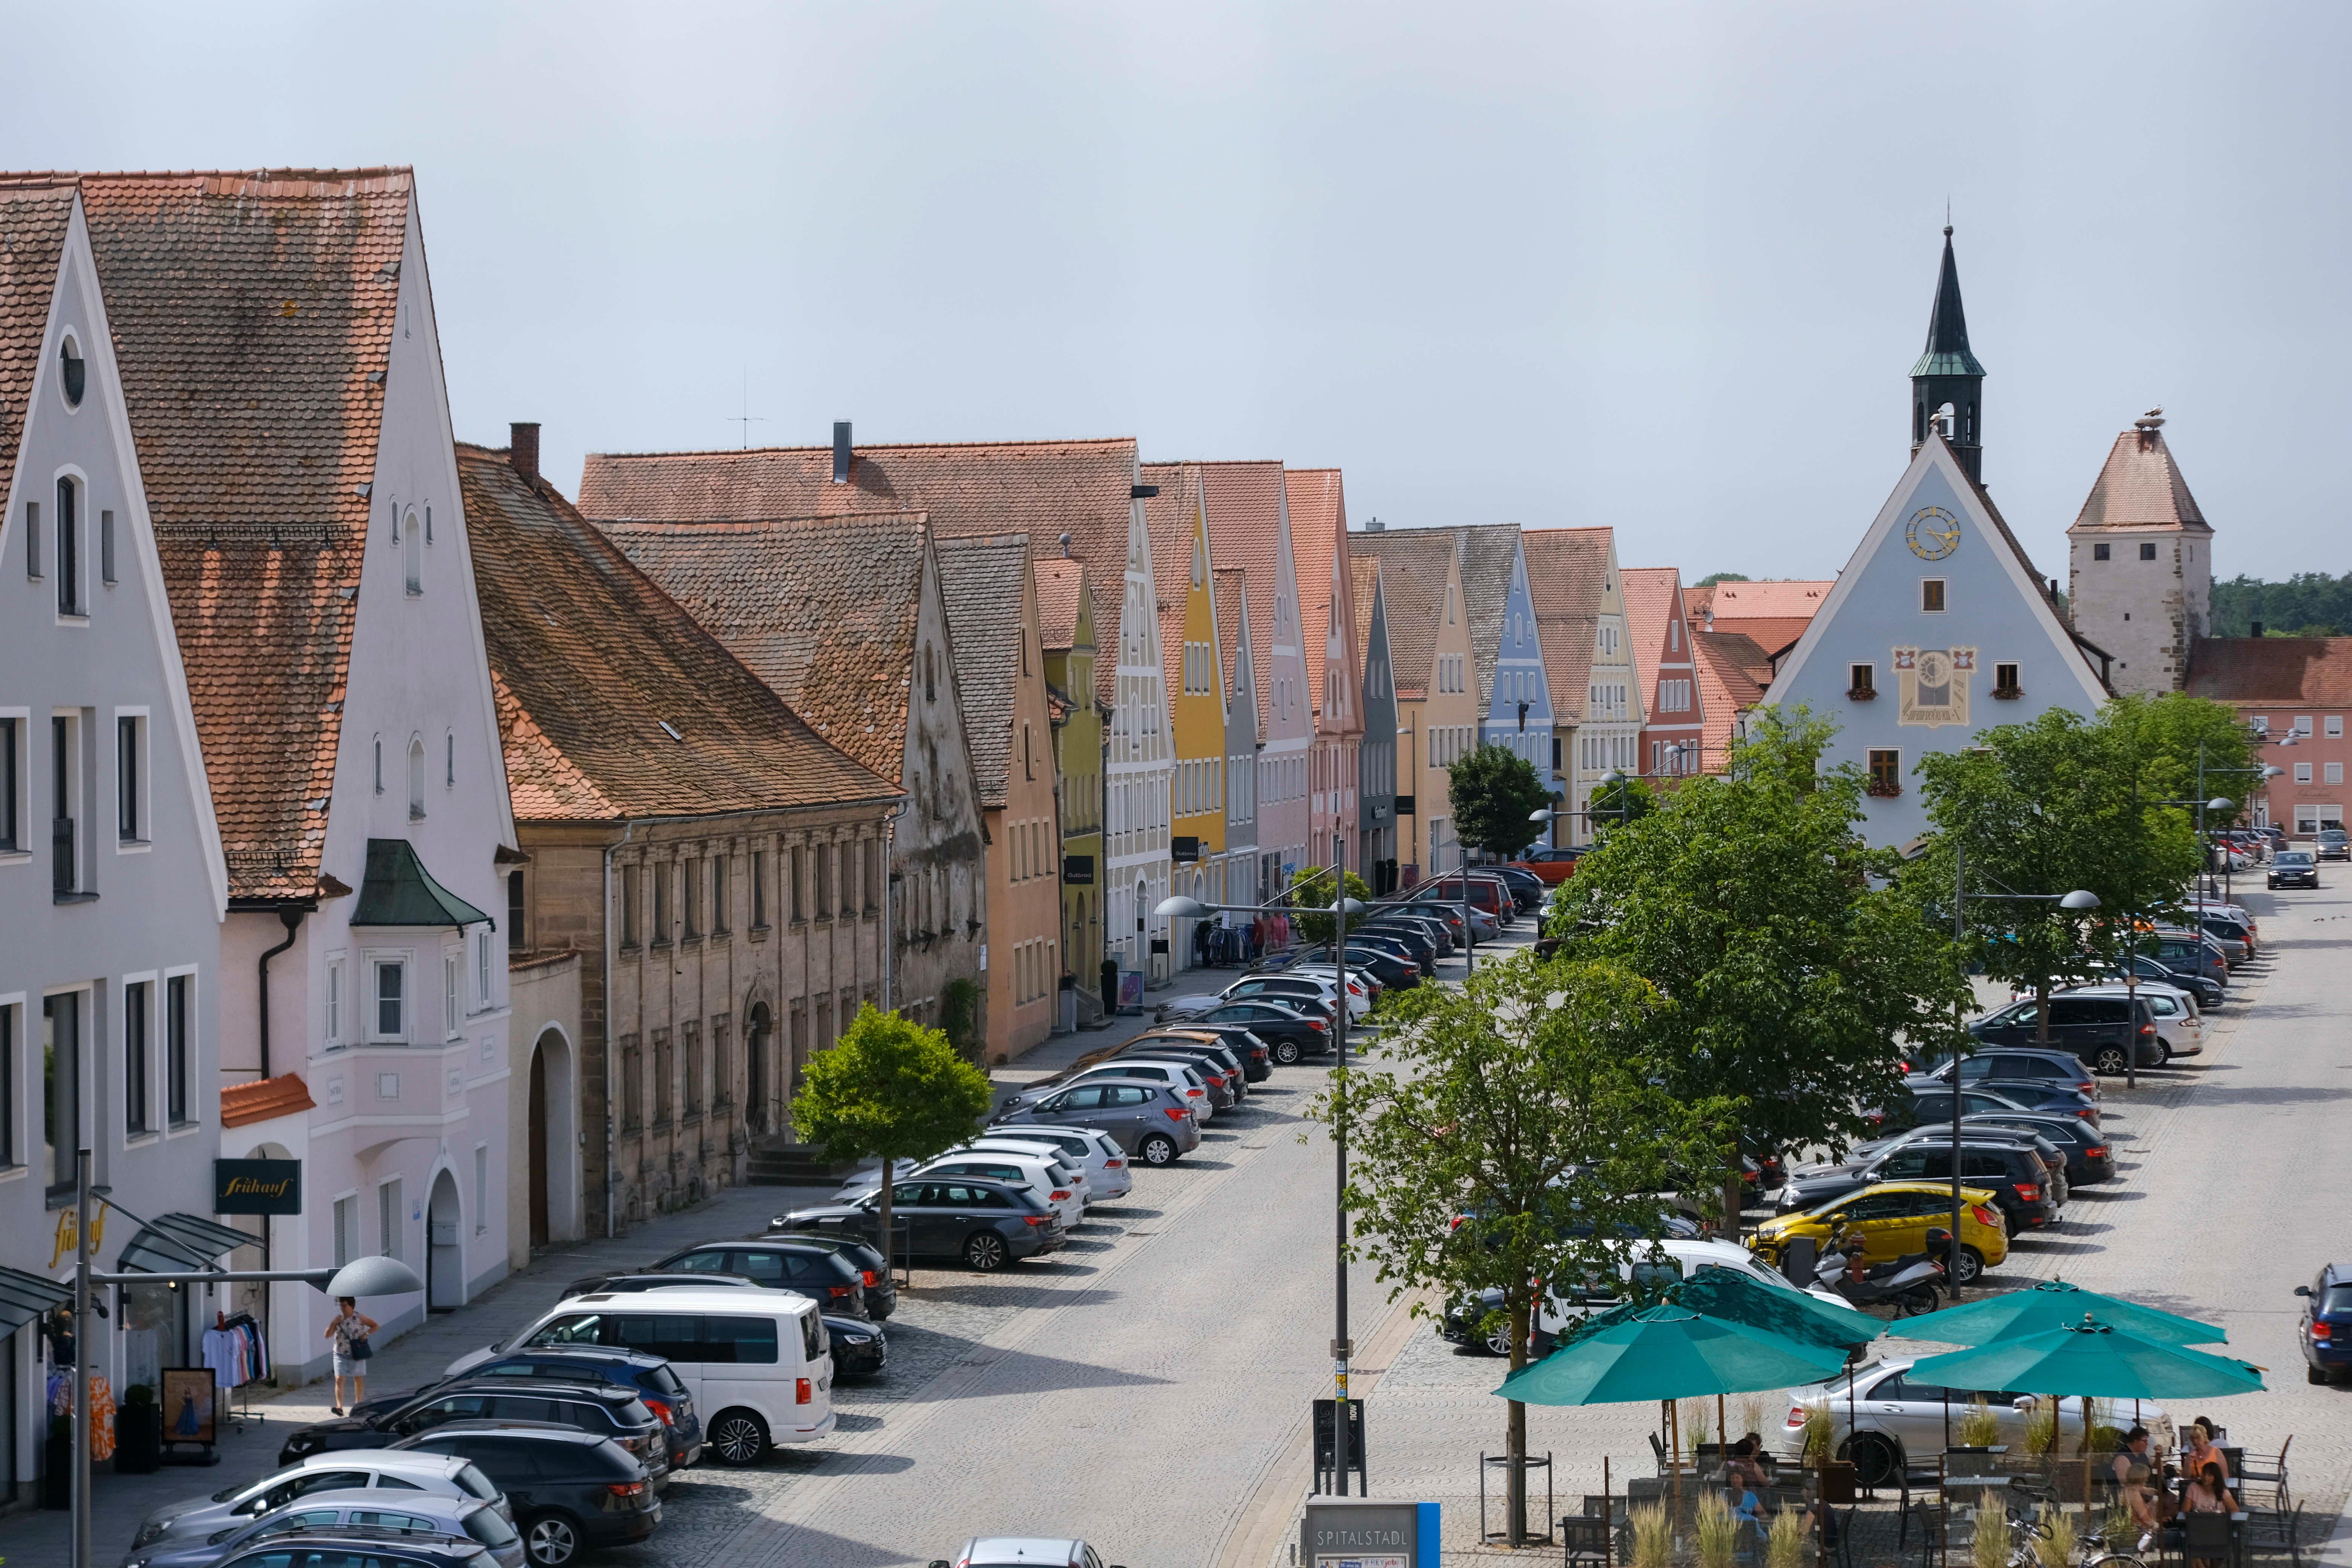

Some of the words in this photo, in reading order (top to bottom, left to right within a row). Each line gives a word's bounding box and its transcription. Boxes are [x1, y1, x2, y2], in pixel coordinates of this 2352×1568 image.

[219, 1176, 294, 1198] frühauf
[48, 1203, 109, 1269] früuf
[1318, 1531, 1407, 1545] SPITALSTADL
